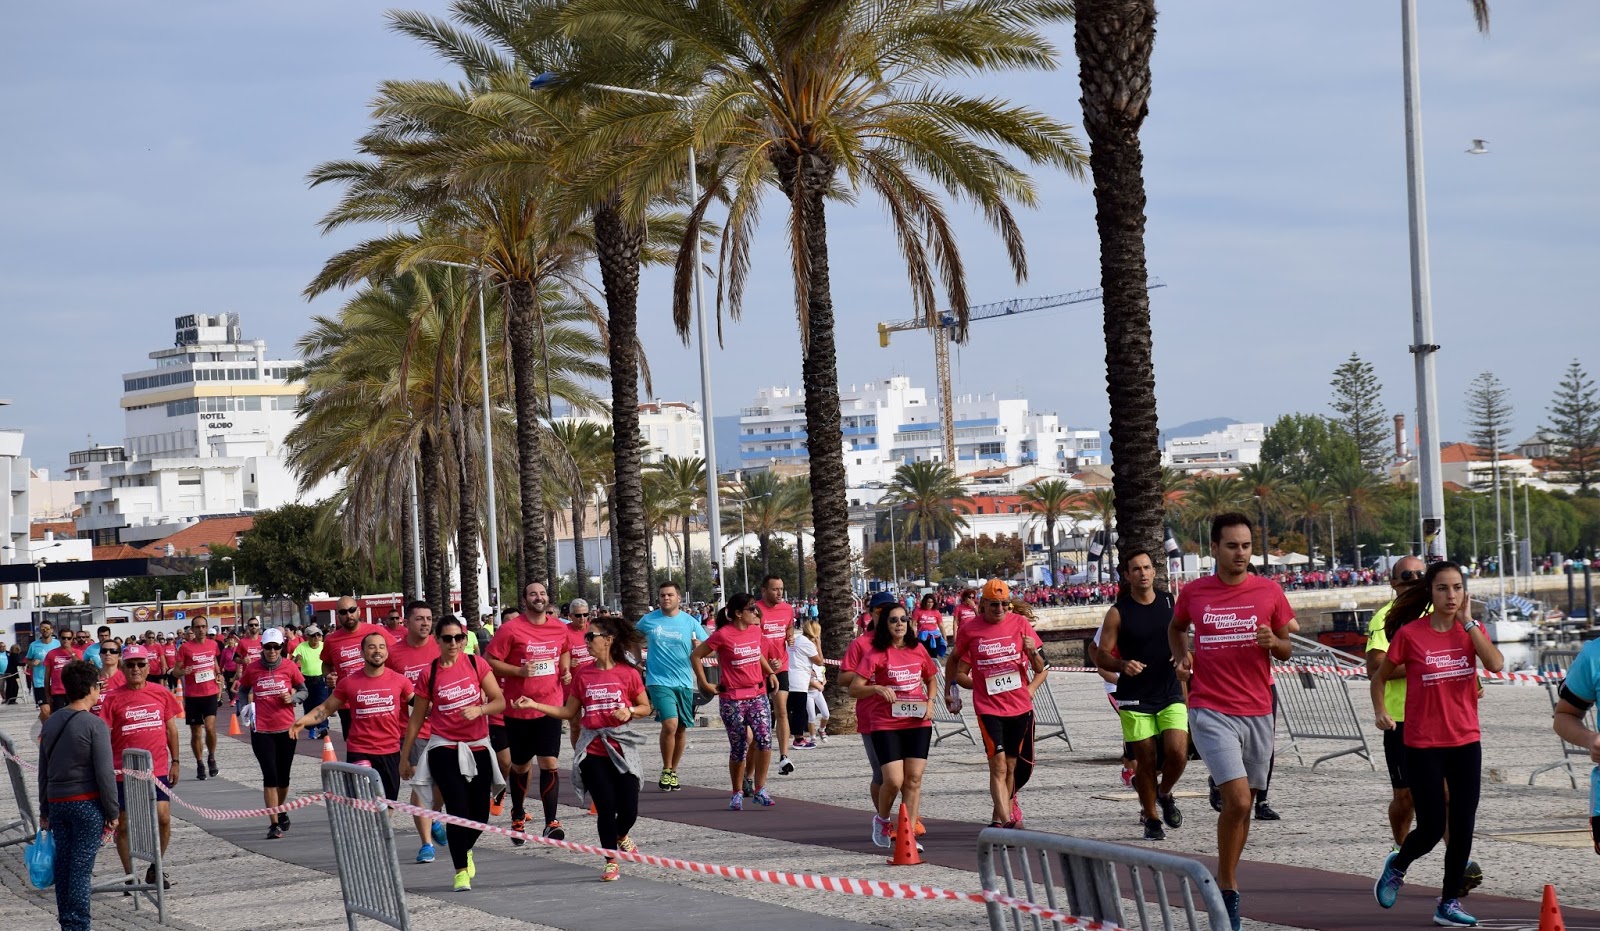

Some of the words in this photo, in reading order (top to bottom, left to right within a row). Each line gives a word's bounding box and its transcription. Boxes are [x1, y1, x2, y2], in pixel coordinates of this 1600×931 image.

[175, 315, 196, 329] HOTEL
[1204, 613, 1236, 623] Mama
[995, 676, 1012, 687] 614
[901, 703, 918, 711] 615
